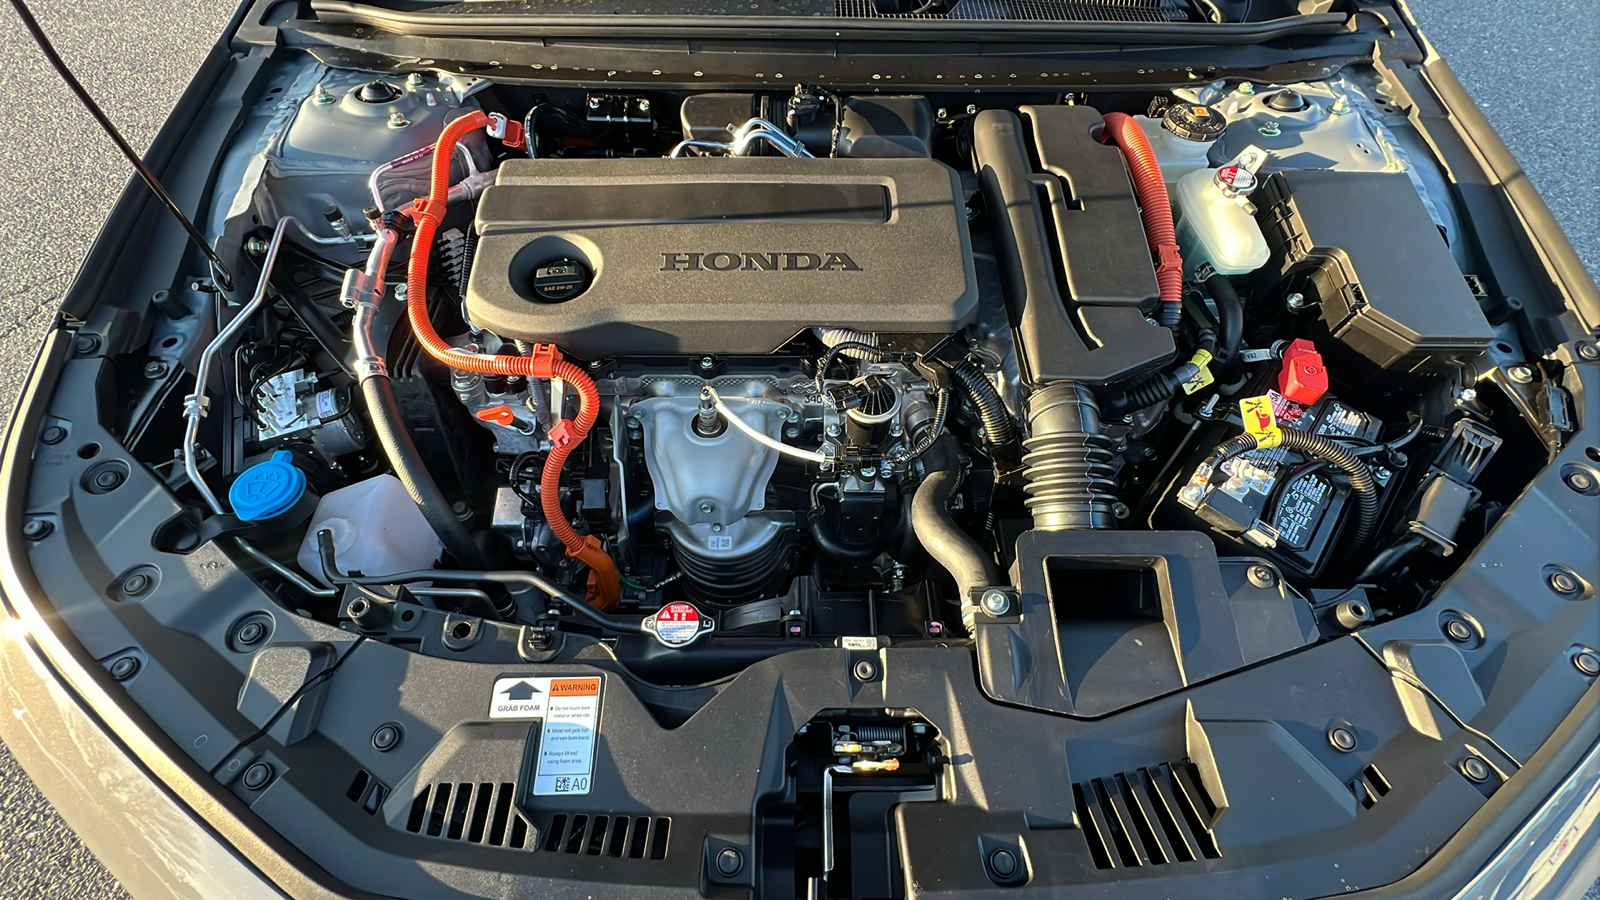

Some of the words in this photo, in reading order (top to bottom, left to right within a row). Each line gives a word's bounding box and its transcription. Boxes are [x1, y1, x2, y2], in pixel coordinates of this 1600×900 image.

[660, 252, 863, 272] HONDA
[804, 394, 822, 404] 340
[560, 683, 597, 692] WARNING
[571, 778, 588, 791] A0
